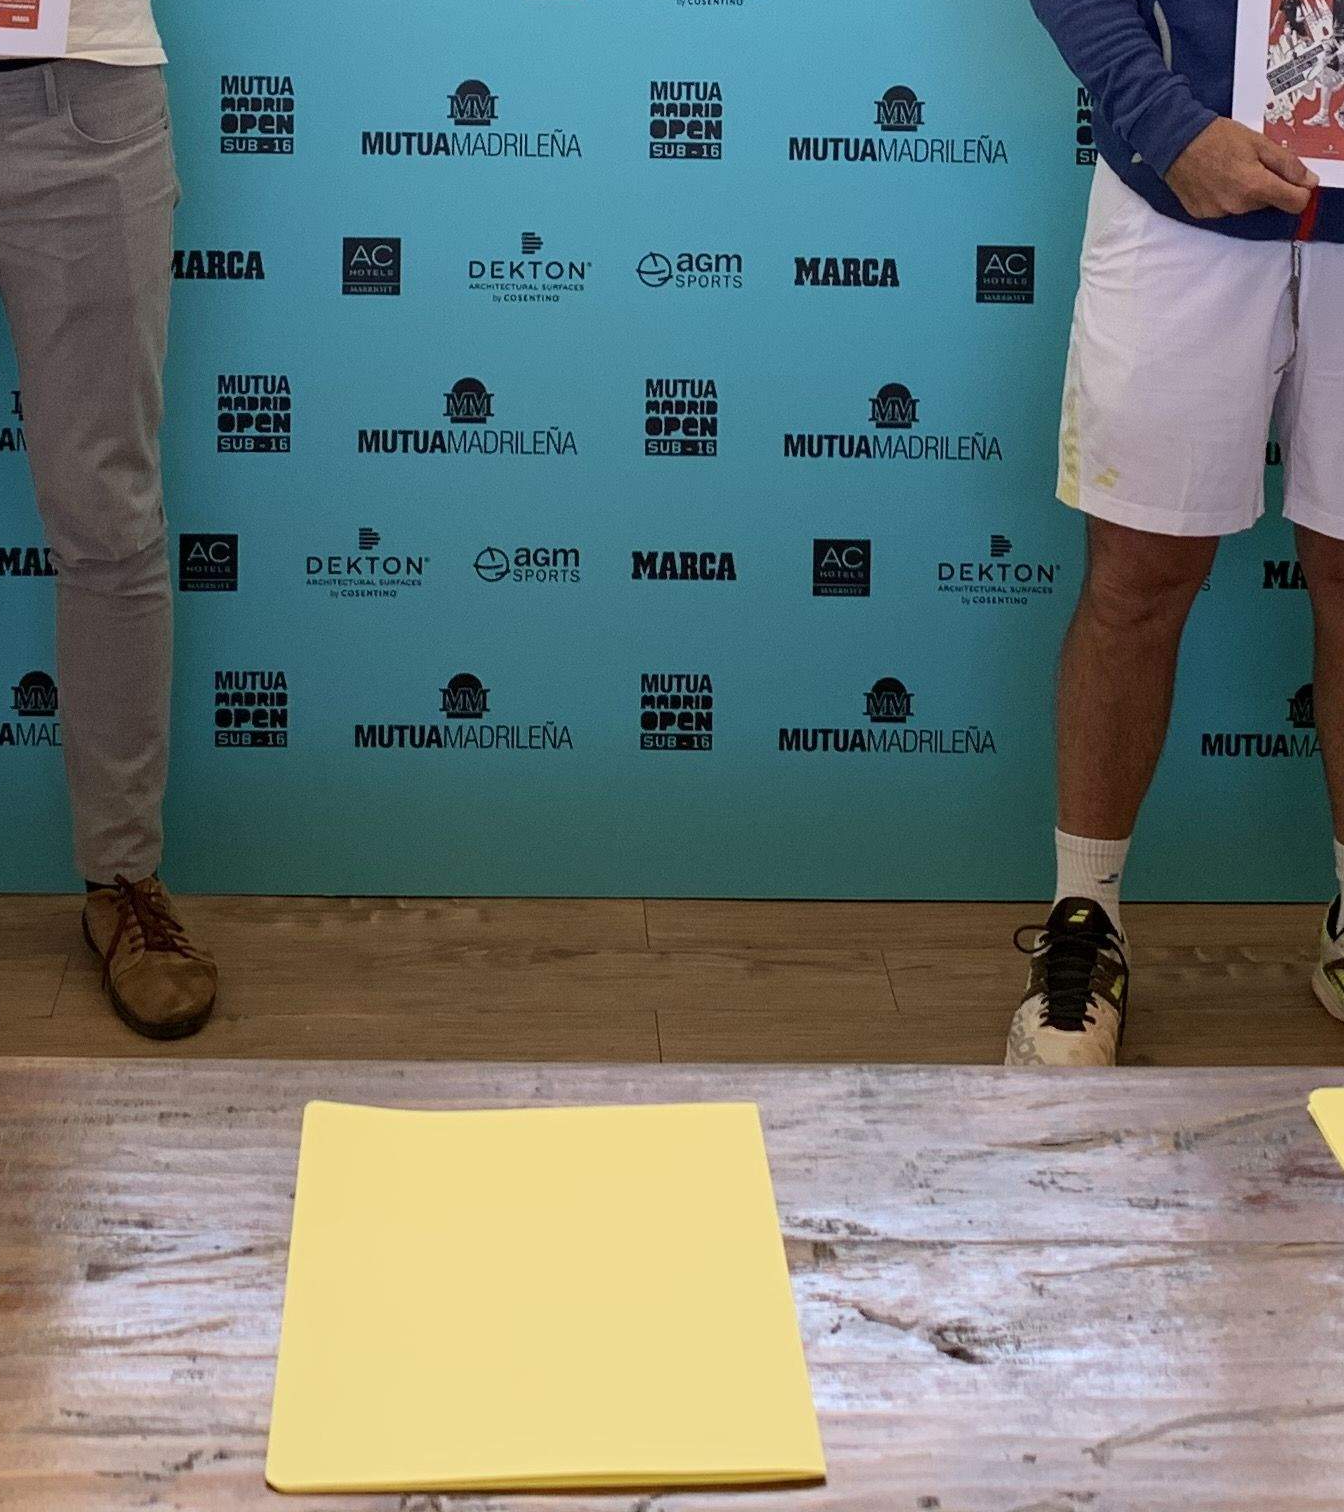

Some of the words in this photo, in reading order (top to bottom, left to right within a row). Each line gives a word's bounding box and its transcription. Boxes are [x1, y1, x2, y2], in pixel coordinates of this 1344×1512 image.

[221, 75, 294, 96] MUTUA
[650, 80, 723, 101] MUTUA
[221, 97, 294, 112] MADRID
[650, 102, 723, 118] MADRID
[221, 113, 294, 135] OPEN
[650, 119, 723, 140] OPEN
[361, 129, 583, 158] MUTUAMADRILEÑA
[788, 134, 1009, 164] MUTUAMADRILEÑA
[349, 244, 394, 267] AC
[983, 252, 1028, 275] AC
[468, 260, 585, 280] DEKTON
[675, 273, 743, 288] SPORTS
[794, 256, 899, 287] MARCA
[217, 374, 291, 395] MUTUA
[645, 378, 717, 399] MUTUA
[217, 396, 291, 411] MADRID
[645, 400, 718, 415] MADRID
[217, 412, 291, 433] OPEN
[645, 416, 718, 437] OPEN
[357, 427, 578, 456] MUTUAMADRILEÑA
[784, 432, 1003, 461] MUTUAMADRILEÑA
[306, 556, 423, 575] DEKTON
[631, 551, 736, 581] MARCA
[820, 546, 864, 568] AC
[513, 568, 581, 583] SPORTS
[938, 563, 1054, 582] DEKTON
[214, 671, 287, 690] MUTUA
[640, 674, 713, 693] MUTUA
[355, 722, 573, 750] MUTUAMADRILEÑA
[778, 726, 997, 754] MUTUAMADRILEÑA
